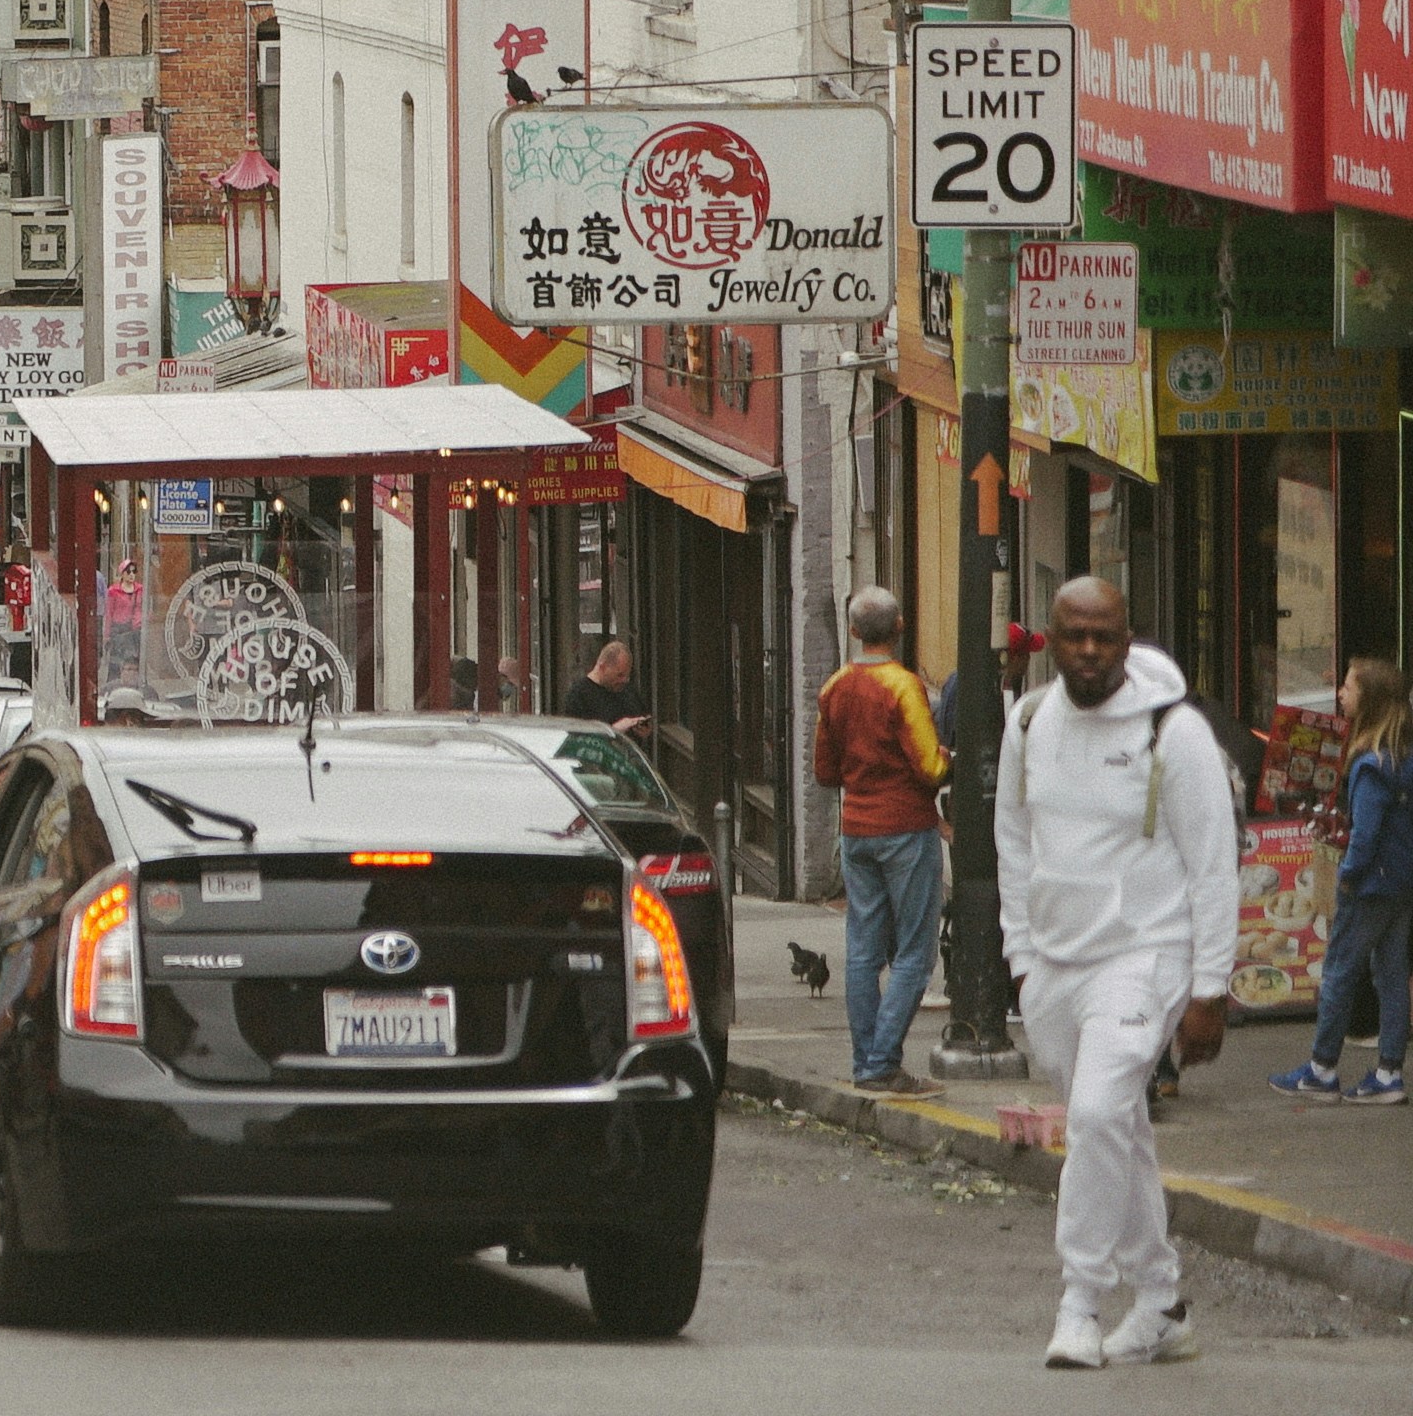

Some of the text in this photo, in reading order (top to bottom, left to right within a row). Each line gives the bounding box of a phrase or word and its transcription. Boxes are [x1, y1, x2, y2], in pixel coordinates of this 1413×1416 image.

[927, 48, 1061, 77] SPEED
[1079, 28, 1285, 149] New Went Worth Trading Co.
[941, 90, 1046, 119] LIMIT
[1363, 67, 1408, 142] New
[1096, 123, 1133, 165] Jackson
[1133, 133, 1148, 168] St.
[931, 131, 1056, 204] 20
[1348, 156, 1378, 193] Jackson
[1379, 164, 1393, 196] St.
[115, 149, 149, 310] SOUVENIR
[520, 211, 621, 264] 如意
[763, 214, 884, 252] Donald
[1021, 247, 1133, 278] NO PARKING
[526, 270, 681, 310] 首飾公司
[707, 267, 877, 313] Jewelry Co.
[1028, 319, 1126, 340] TUE THUR SUN
[6, 353, 52, 367] NEW
[1027, 347, 1126, 362] STREET CLEANING
[16, 370, 53, 385] LOY
[161, 362, 214, 378] NO PARKING
[160, 489, 198, 500] License
[160, 499, 186, 510] Plate
[571, 487, 620, 498] SUPPLIES
[255, 671, 297, 698] OF
[243, 699, 305, 724] DIM
[205, 874, 253, 895] Uber
[336, 1015, 442, 1045] 7MAU911
